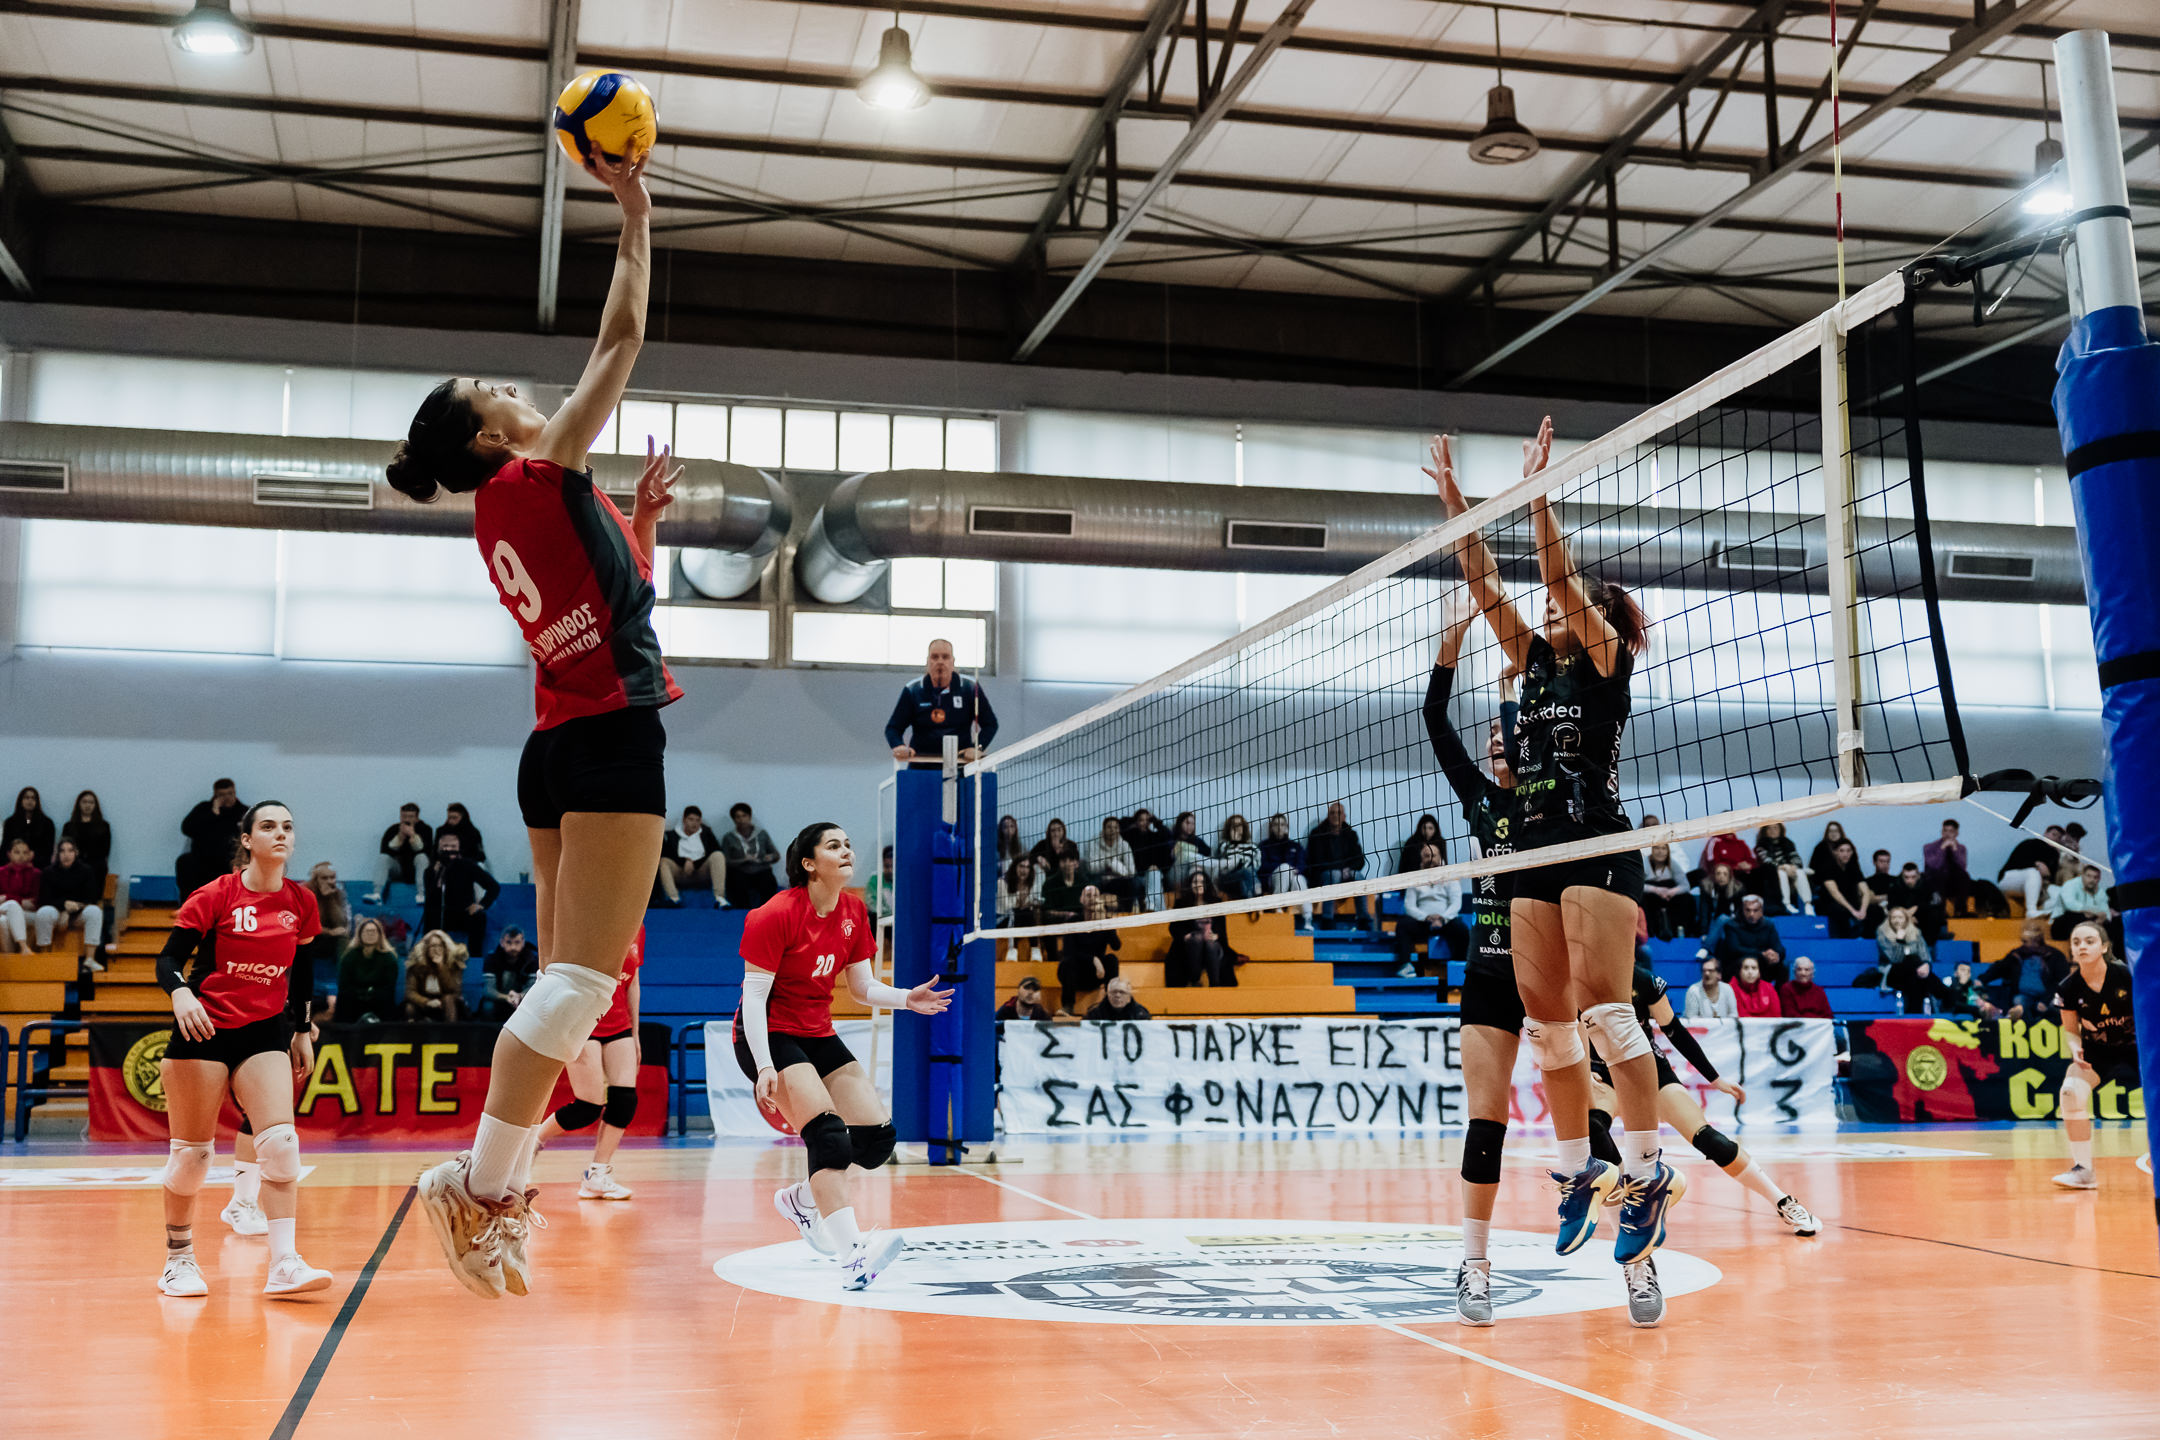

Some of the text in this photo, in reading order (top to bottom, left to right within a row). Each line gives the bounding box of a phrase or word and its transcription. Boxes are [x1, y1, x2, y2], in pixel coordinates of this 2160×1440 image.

[492, 539, 543, 624] 9
[231, 905, 258, 933] 16
[811, 953, 836, 978] 20
[1167, 1022, 1302, 1065] ΠΑΡΚΕ
[1041, 1077, 1463, 1128] ΣΑΣ ΦΩΝΑΖΟΥΝΕ
